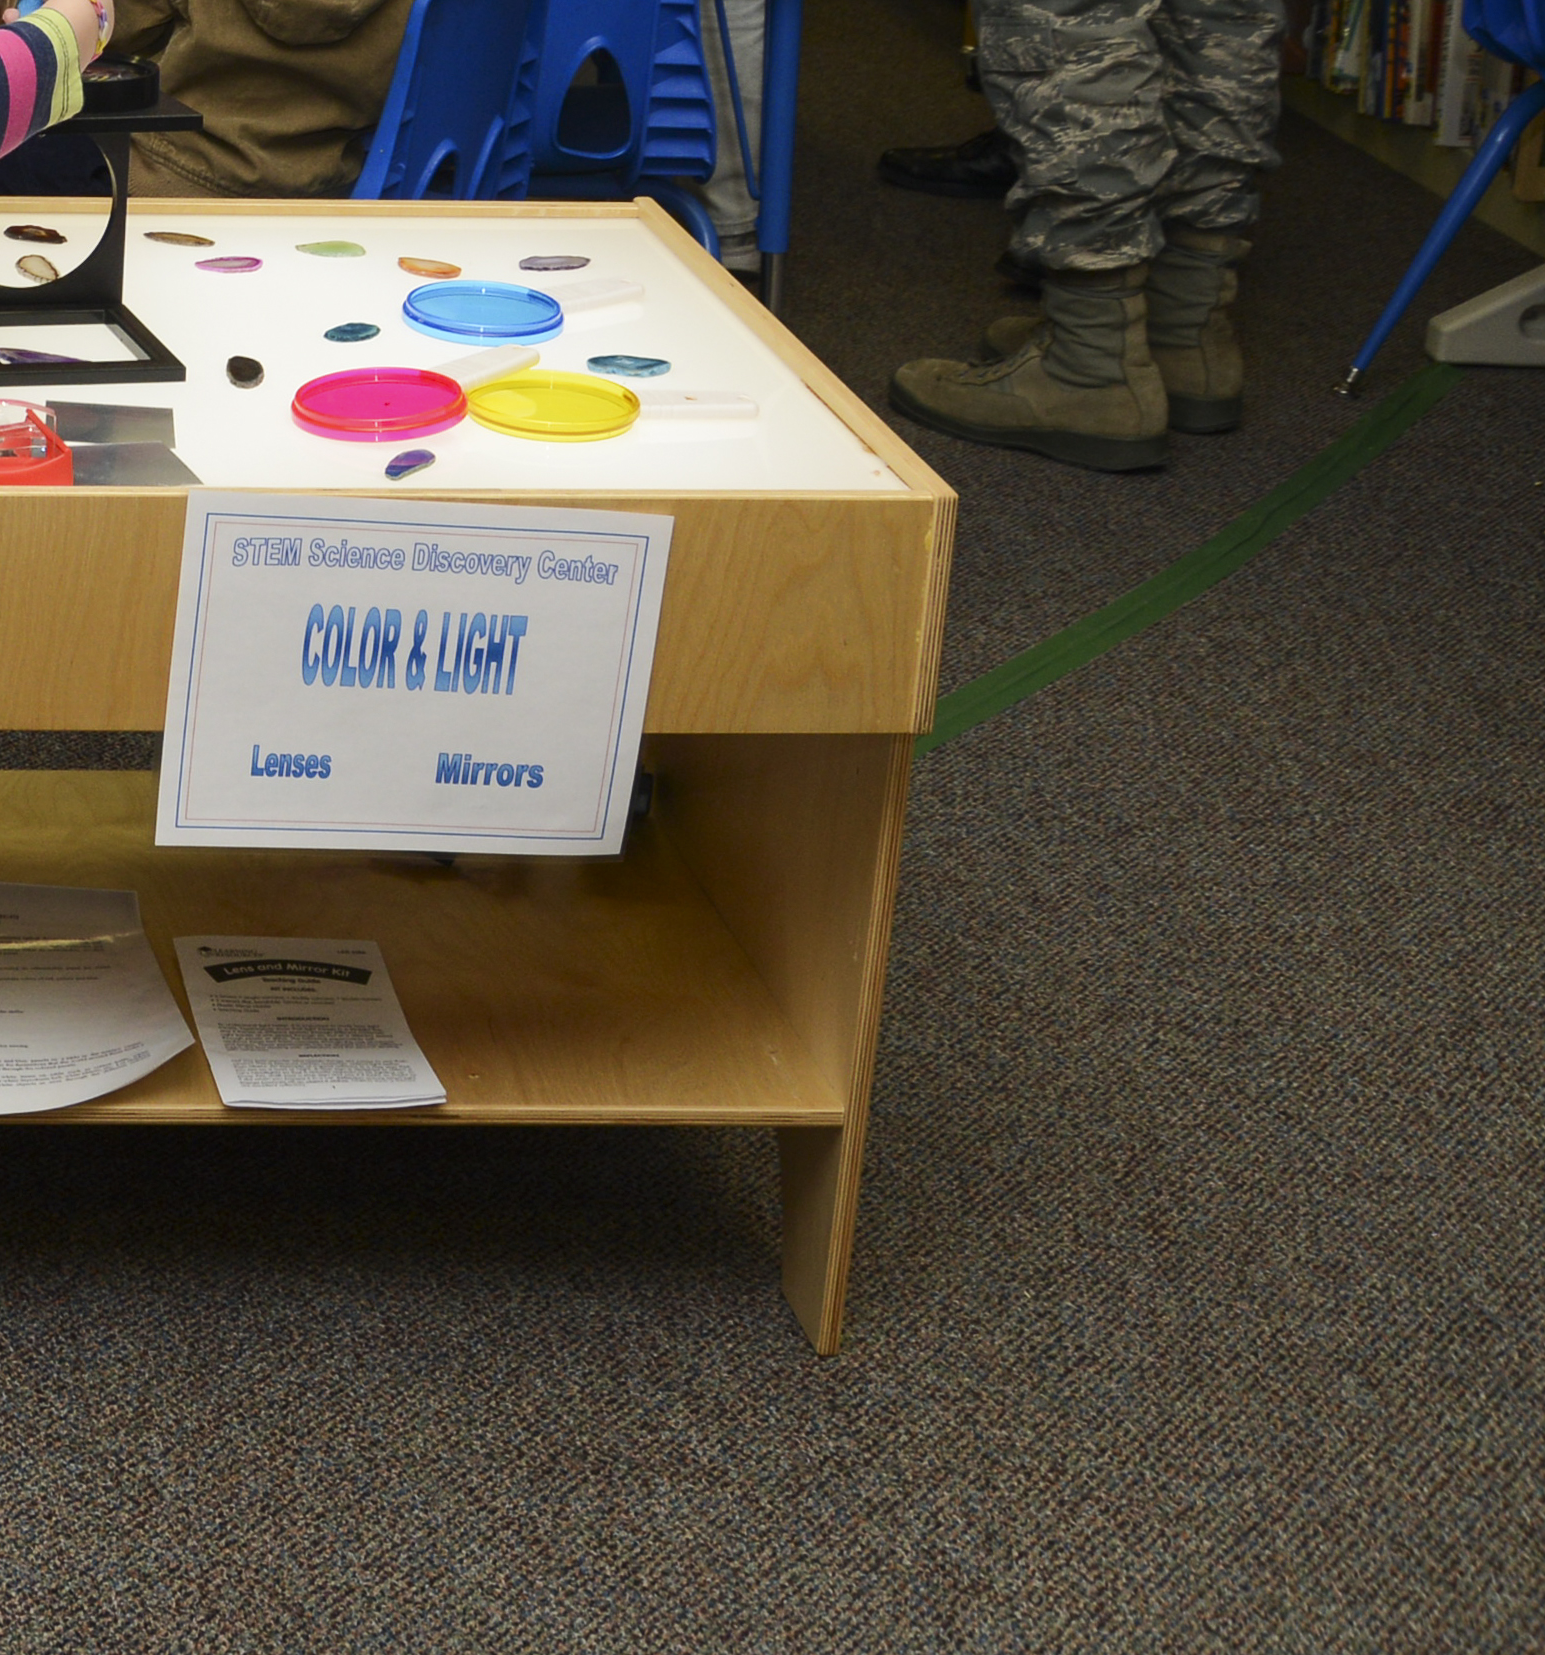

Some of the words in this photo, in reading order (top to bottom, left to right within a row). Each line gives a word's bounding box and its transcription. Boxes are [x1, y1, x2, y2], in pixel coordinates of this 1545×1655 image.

[232, 537, 303, 567] STEM
[308, 538, 406, 571] Science
[411, 542, 532, 584] Discovery
[536, 549, 619, 585] Center
[301, 603, 402, 689] COLOR
[404, 609, 429, 691] &
[433, 610, 529, 695] LIGHT
[250, 744, 332, 779] Lenses
[435, 752, 545, 788] Mirrors
[223, 965, 255, 976] Lens
[257, 962, 283, 971] and
[286, 962, 329, 974] Mirror
[331, 968, 351, 978] Kit
